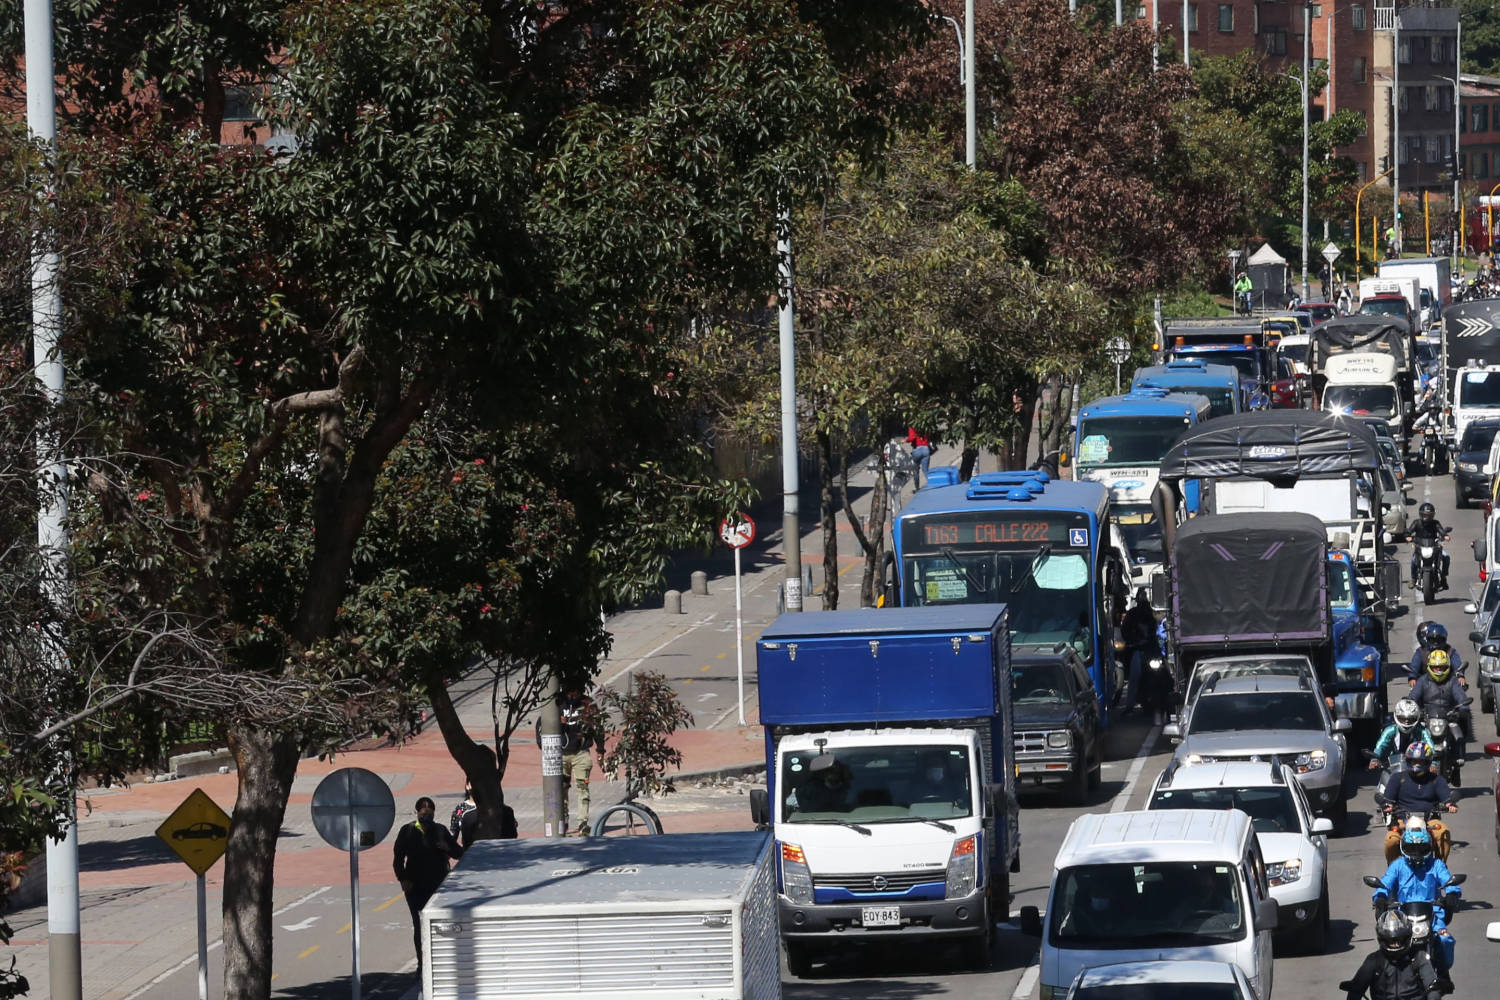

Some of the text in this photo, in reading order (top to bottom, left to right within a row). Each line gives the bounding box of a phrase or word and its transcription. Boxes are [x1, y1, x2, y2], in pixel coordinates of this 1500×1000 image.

[925, 522, 1049, 544] T163 CALLE 222
